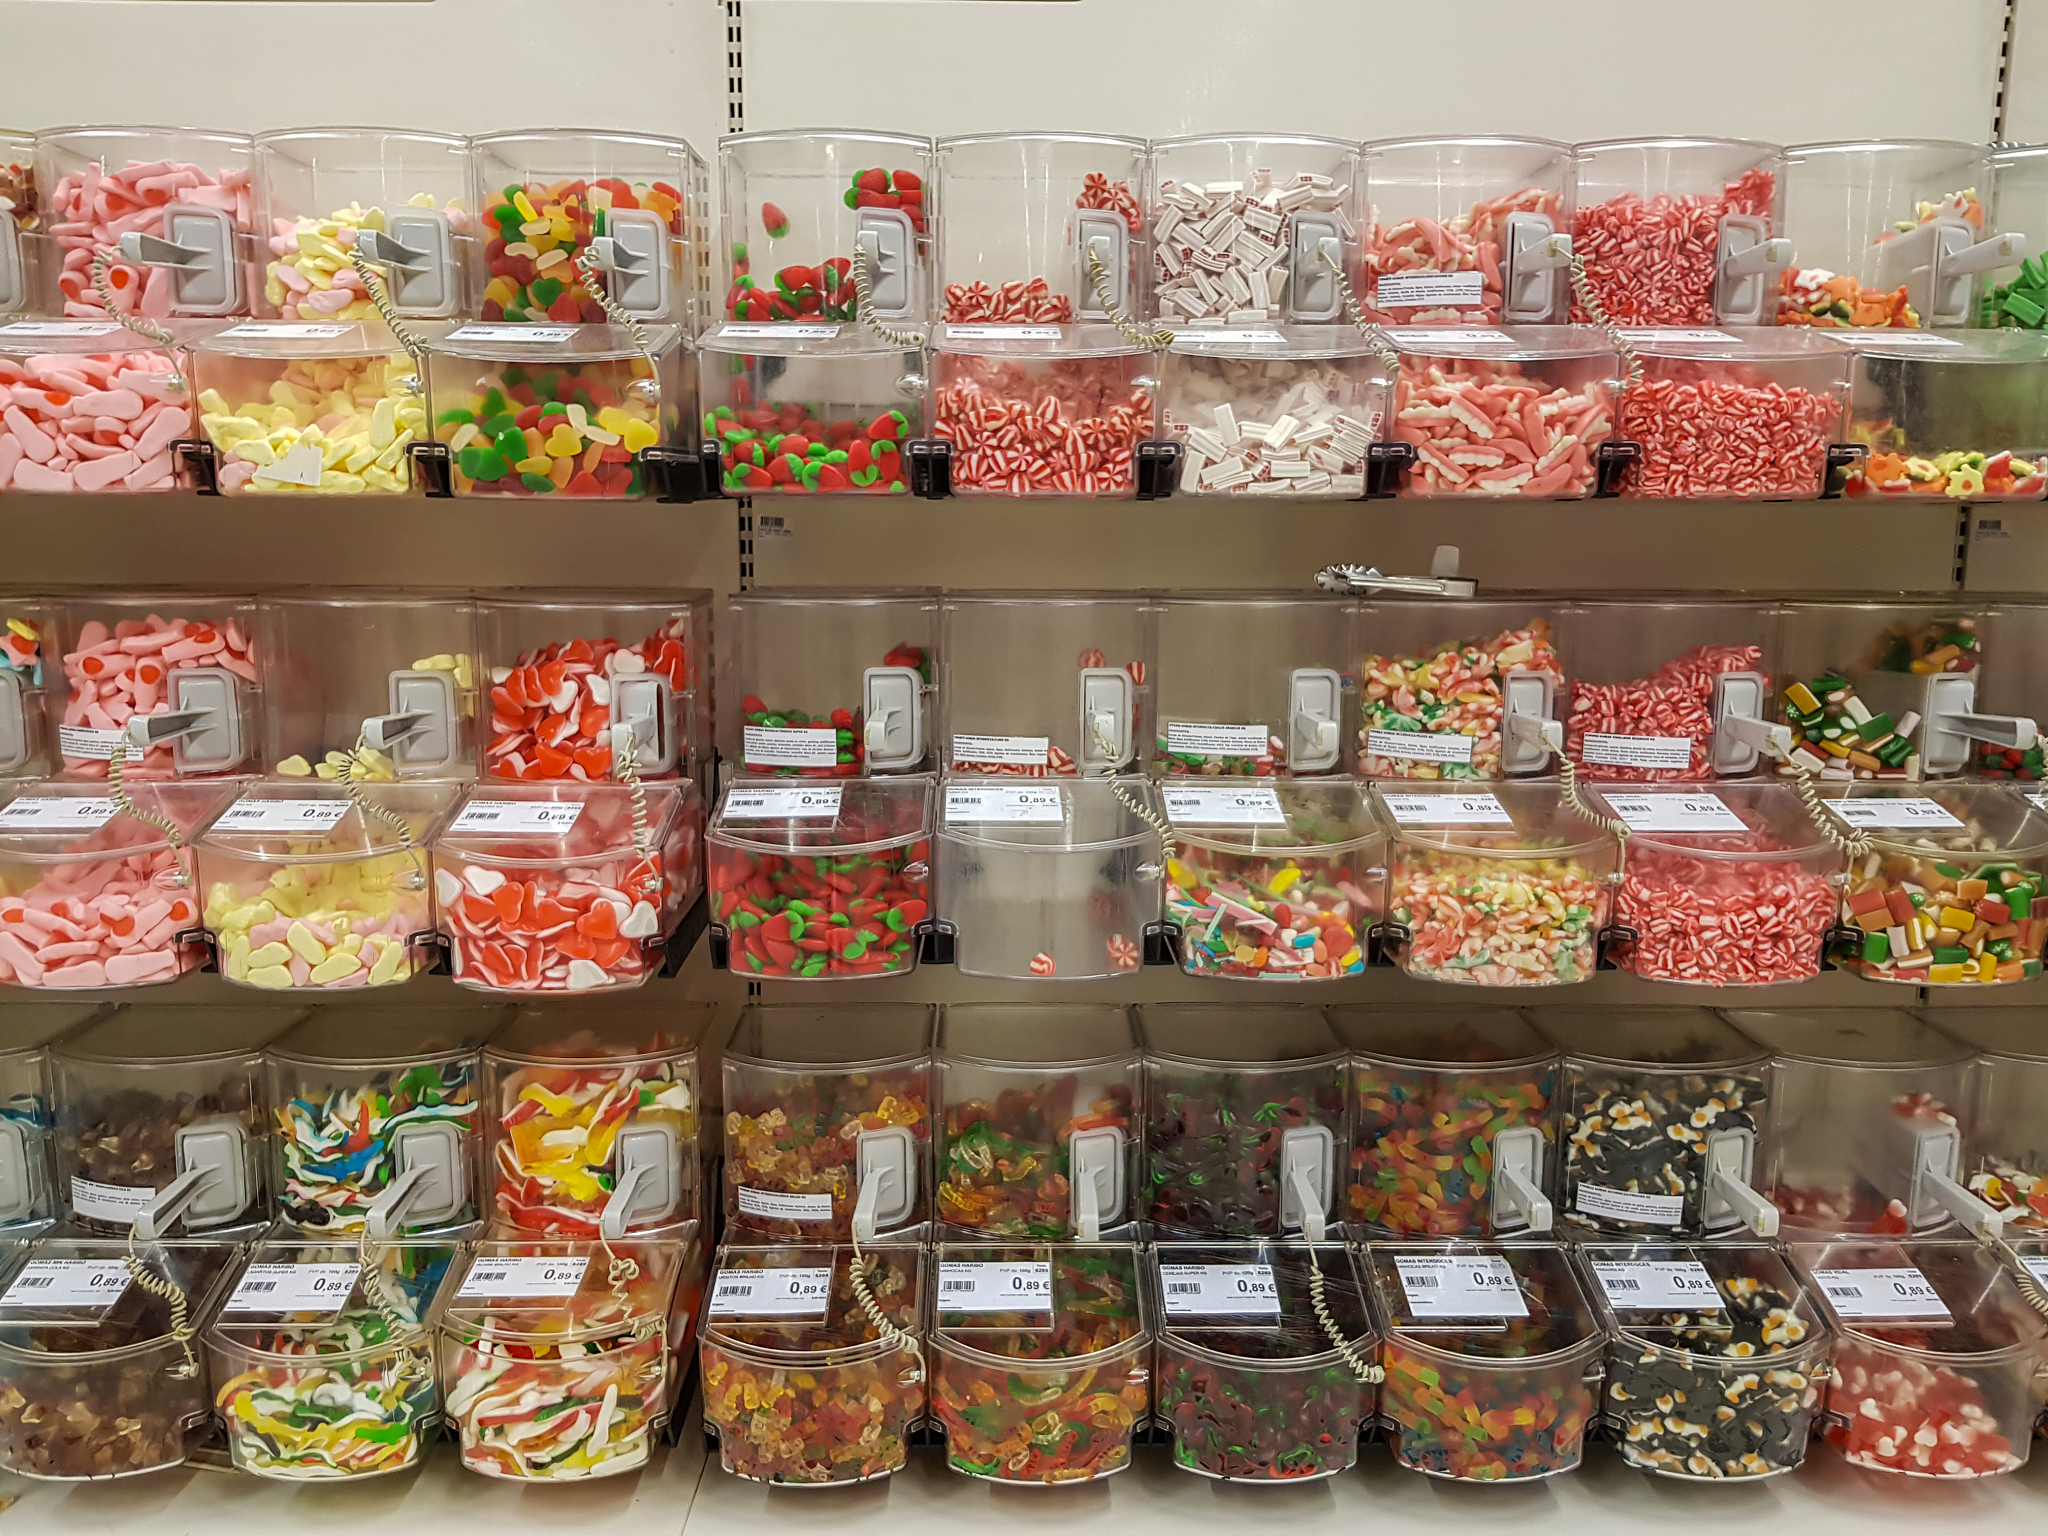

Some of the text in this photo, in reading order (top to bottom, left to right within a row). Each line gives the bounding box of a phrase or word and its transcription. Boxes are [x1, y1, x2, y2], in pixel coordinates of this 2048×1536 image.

[802, 796, 828, 805] 0,89
[1019, 795, 1046, 804] 0,89
[78, 807, 107, 815] 0,89
[1463, 802, 1492, 811] 0,89
[1684, 803, 1715, 812] 0,89
[303, 809, 331, 818] 0,89
[90, 1274, 129, 1287] 0,89 €
[544, 1269, 582, 1280] 0,89 €
[1473, 1272, 1512, 1286] 0,89 €
[314, 1278, 353, 1292] 0,89 €
[790, 1281, 828, 1295] 0,89 €
[1012, 1277, 1049, 1291] 0,89 €
[1237, 1279, 1275, 1293] 0,89 €
[1673, 1276, 1713, 1290] 0,89 €
[1893, 1282, 1924, 1296] 0,89
